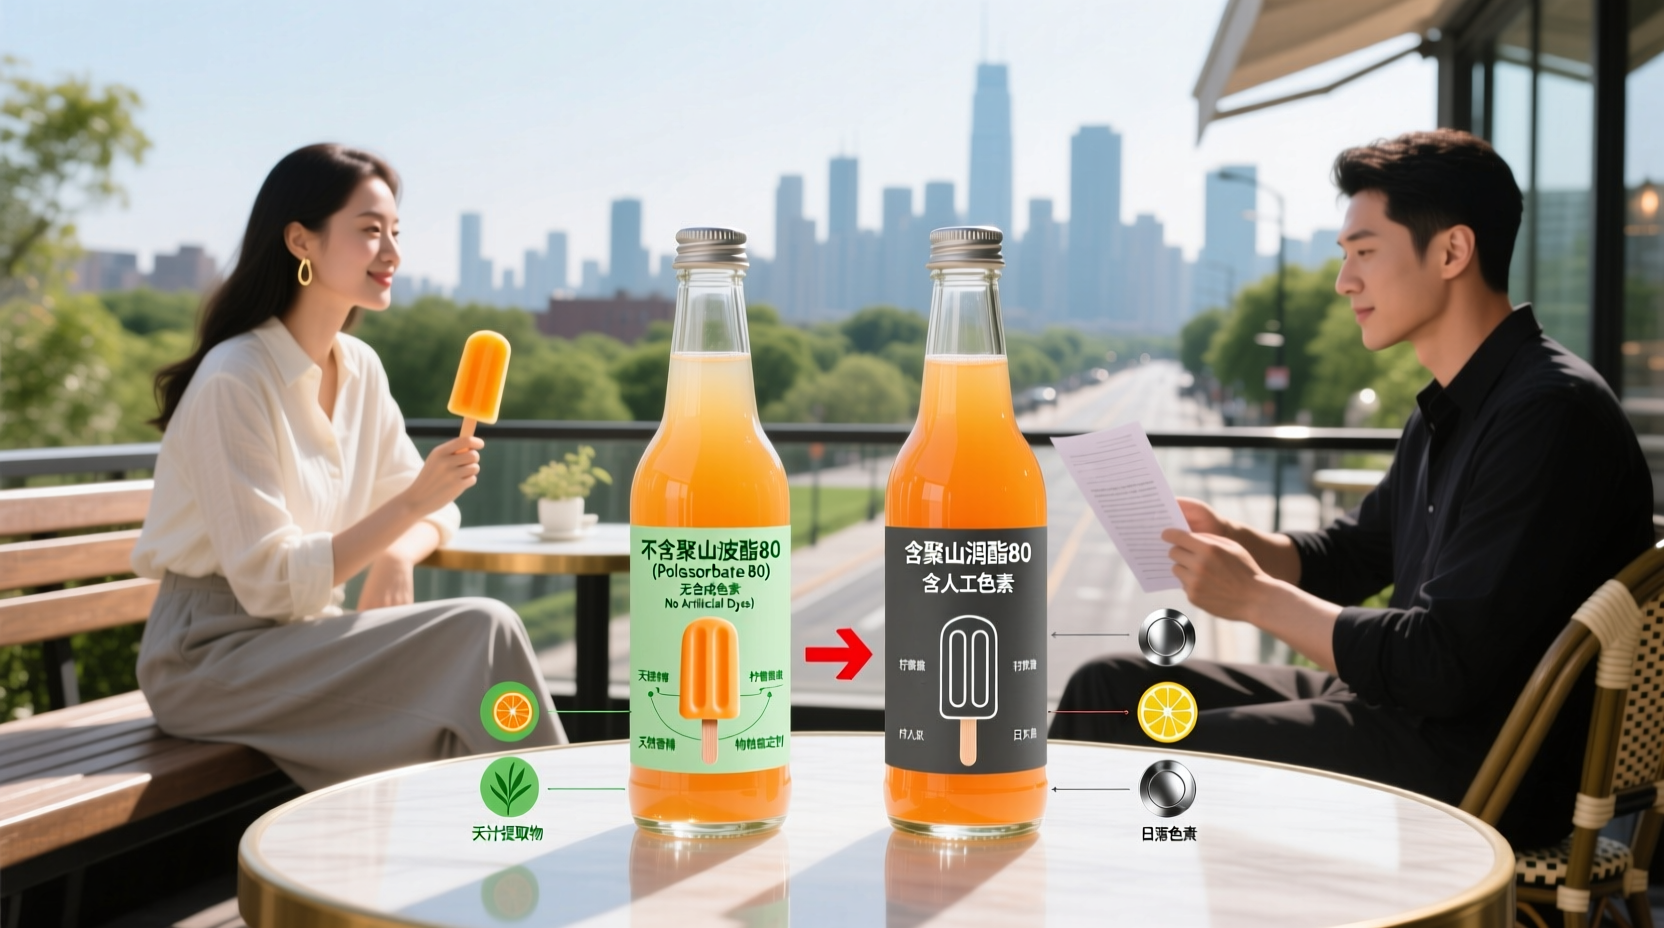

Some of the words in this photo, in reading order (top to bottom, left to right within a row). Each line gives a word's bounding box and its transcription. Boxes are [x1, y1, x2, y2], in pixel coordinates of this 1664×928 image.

[922, 572, 1015, 594] 含人工色素
[665, 597, 679, 609] No
